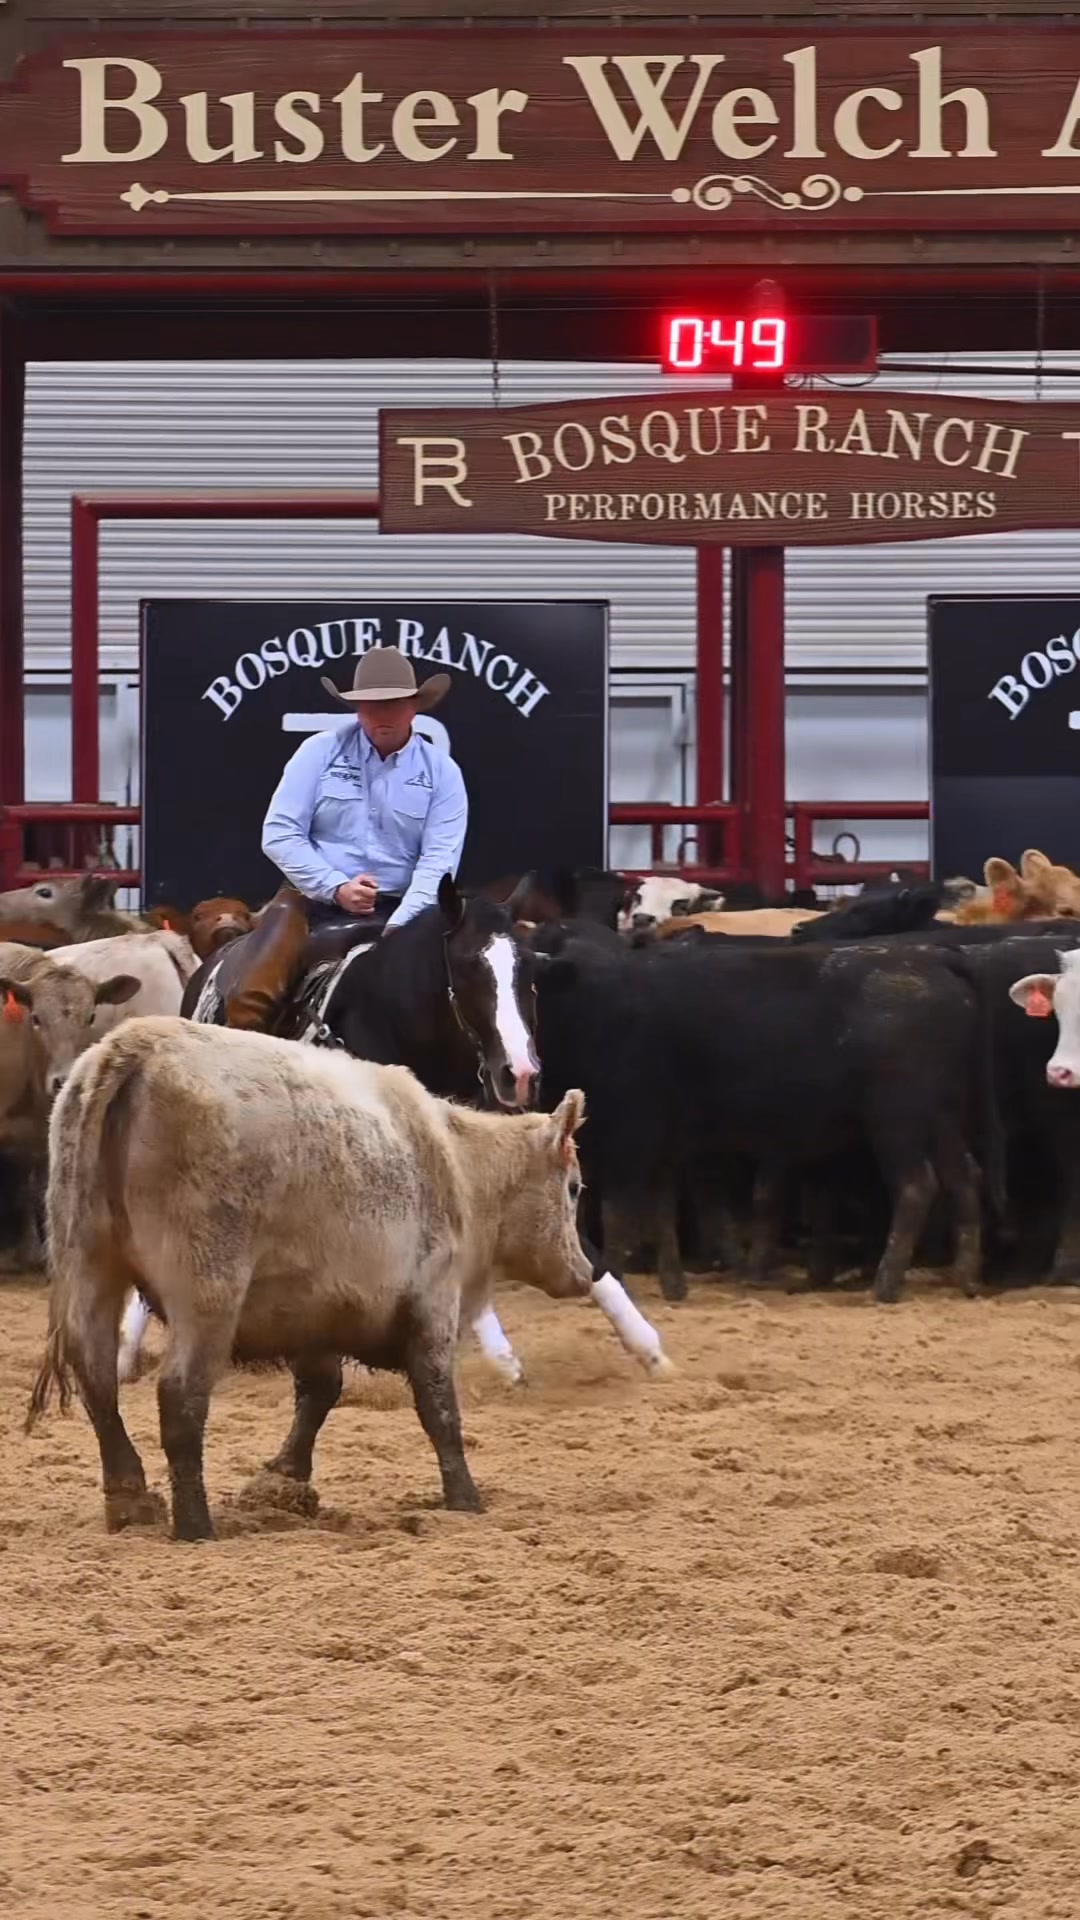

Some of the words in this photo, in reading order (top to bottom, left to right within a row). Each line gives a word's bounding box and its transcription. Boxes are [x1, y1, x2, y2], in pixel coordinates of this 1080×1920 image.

[61, 56, 529, 164] Buster
[563, 45, 997, 162] Welch
[669, 318, 786, 368] 0:49
[502, 404, 771, 485] BOSQUE
[794, 404, 1030, 480] RANCH
[544, 491, 828, 523] PERFORMANCE
[848, 490, 997, 520] HORSES
[201, 617, 381, 722] BOSQUE
[395, 618, 551, 718] RANCH
[987, 626, 1080, 721] BOS
